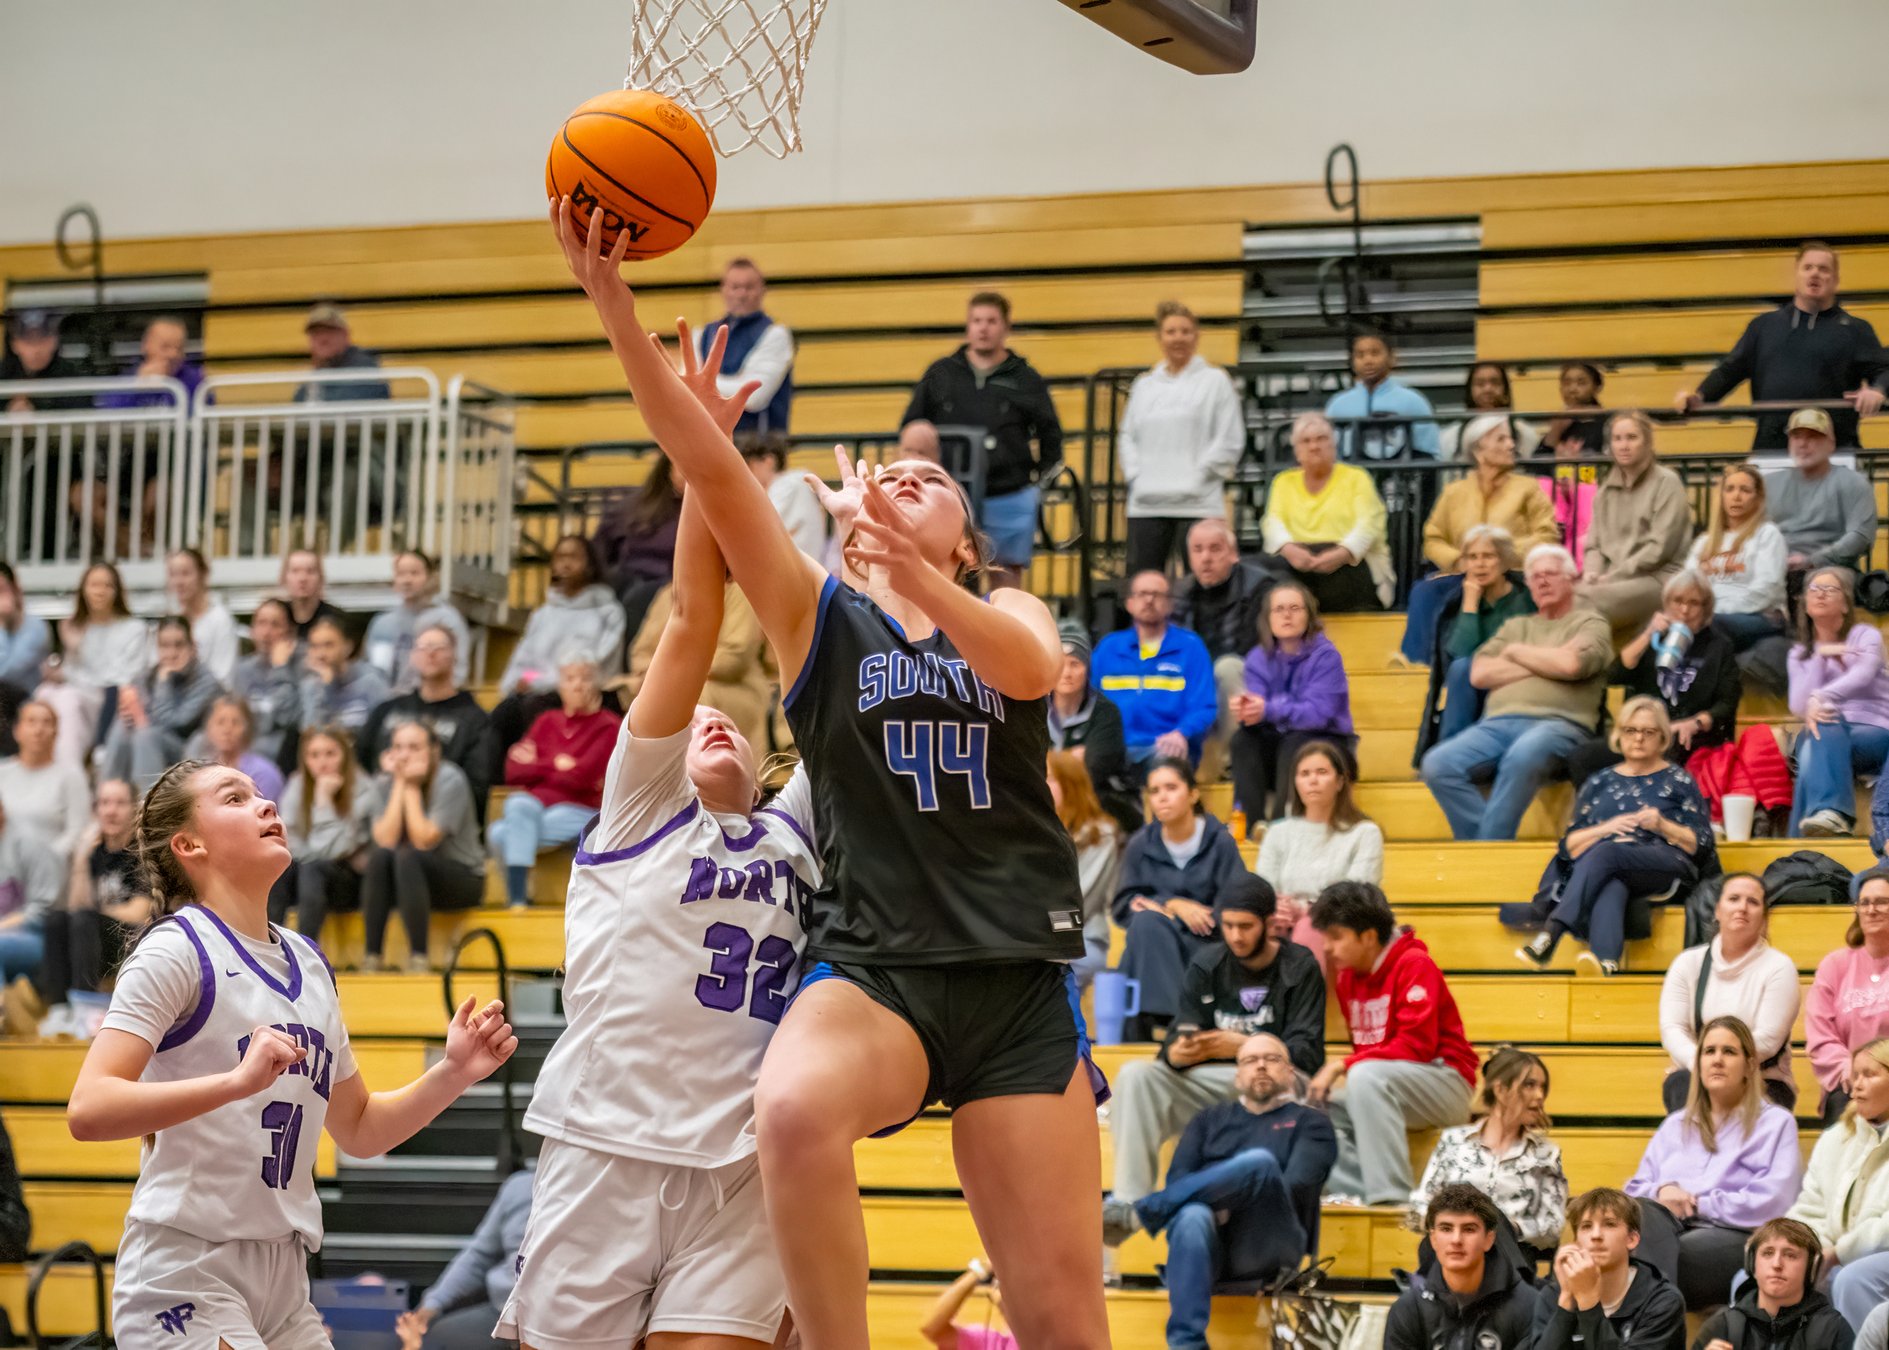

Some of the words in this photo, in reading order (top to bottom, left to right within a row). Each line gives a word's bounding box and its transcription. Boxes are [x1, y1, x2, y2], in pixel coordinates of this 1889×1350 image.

[859, 651, 1005, 723] SOUTH
[883, 720, 992, 812] 44
[694, 921, 798, 1026] 32
